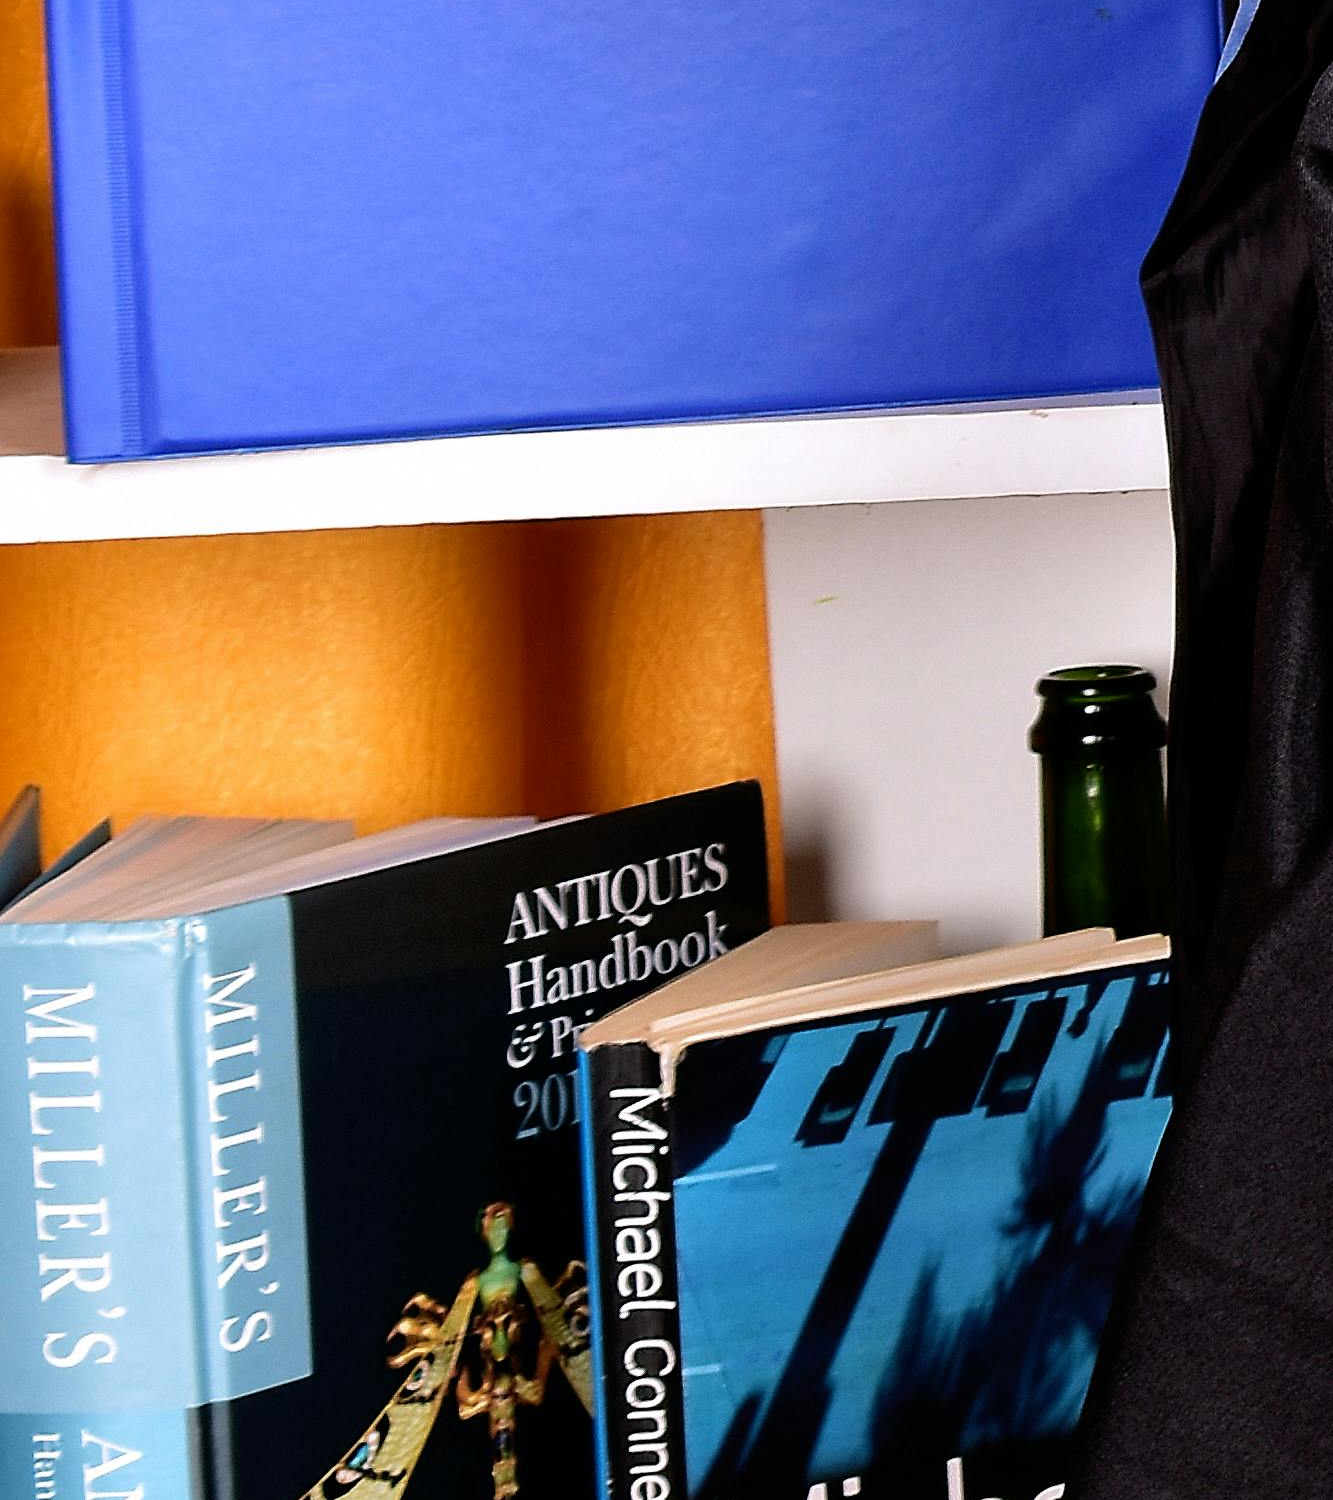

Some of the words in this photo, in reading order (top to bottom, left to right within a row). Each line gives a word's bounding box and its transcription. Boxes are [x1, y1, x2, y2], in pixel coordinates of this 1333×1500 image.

[503, 842, 729, 945] ANTIQUES
[504, 910, 730, 1015] Handbook
[506, 1021, 545, 1069] &
[23, 982, 127, 1369] MILLER'S
[203, 962, 281, 1353] MILLER'S
[609, 1085, 677, 1320] Michael
